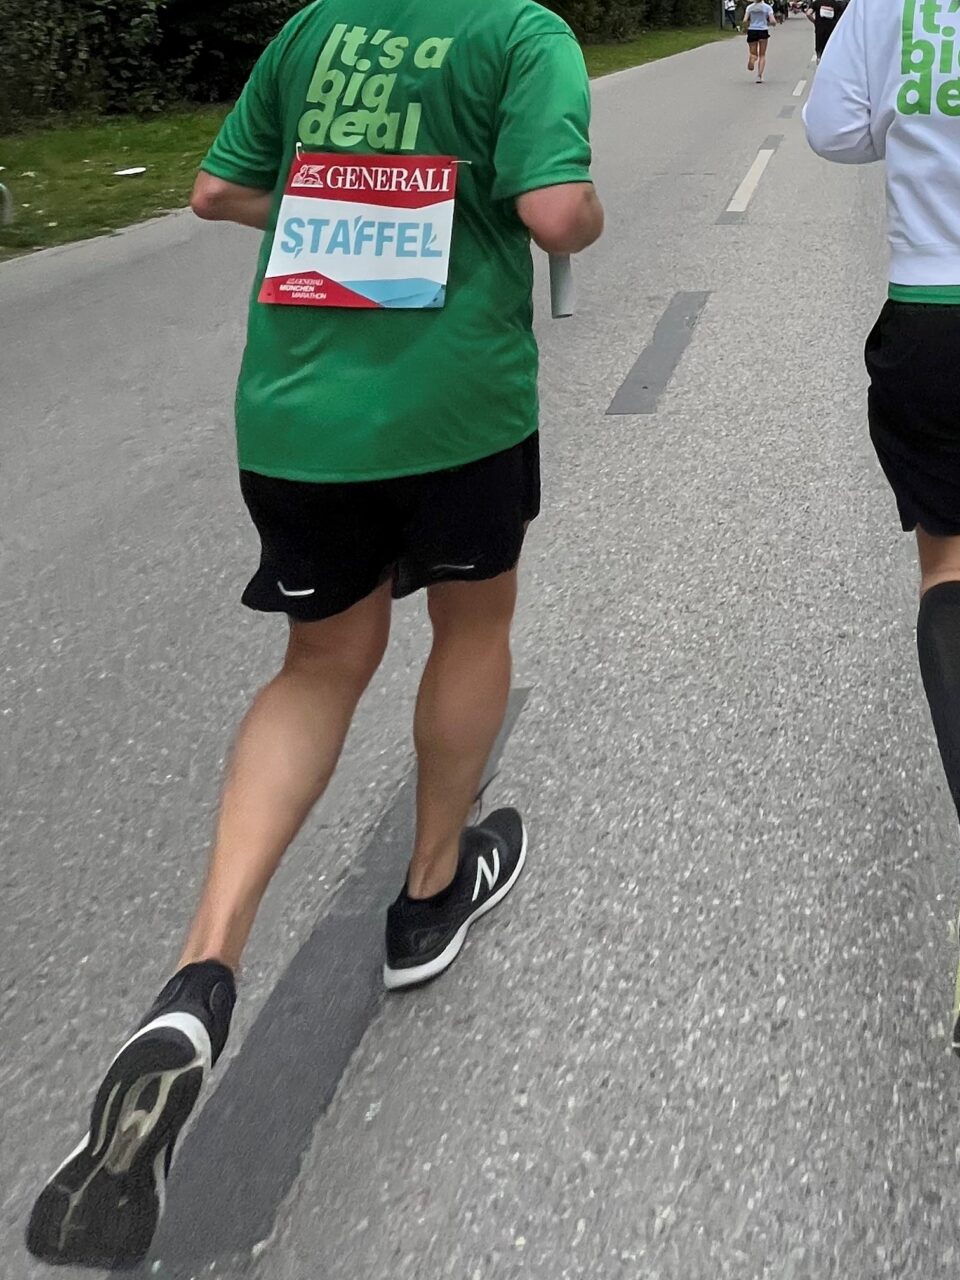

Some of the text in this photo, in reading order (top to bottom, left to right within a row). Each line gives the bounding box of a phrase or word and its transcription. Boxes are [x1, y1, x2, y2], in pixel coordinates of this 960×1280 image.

[317, 23, 455, 69] It's a
[306, 58, 398, 116] big
[298, 101, 422, 150] deal
[326, 165, 452, 192] GENERALI
[280, 215, 443, 259] STAFFEL
